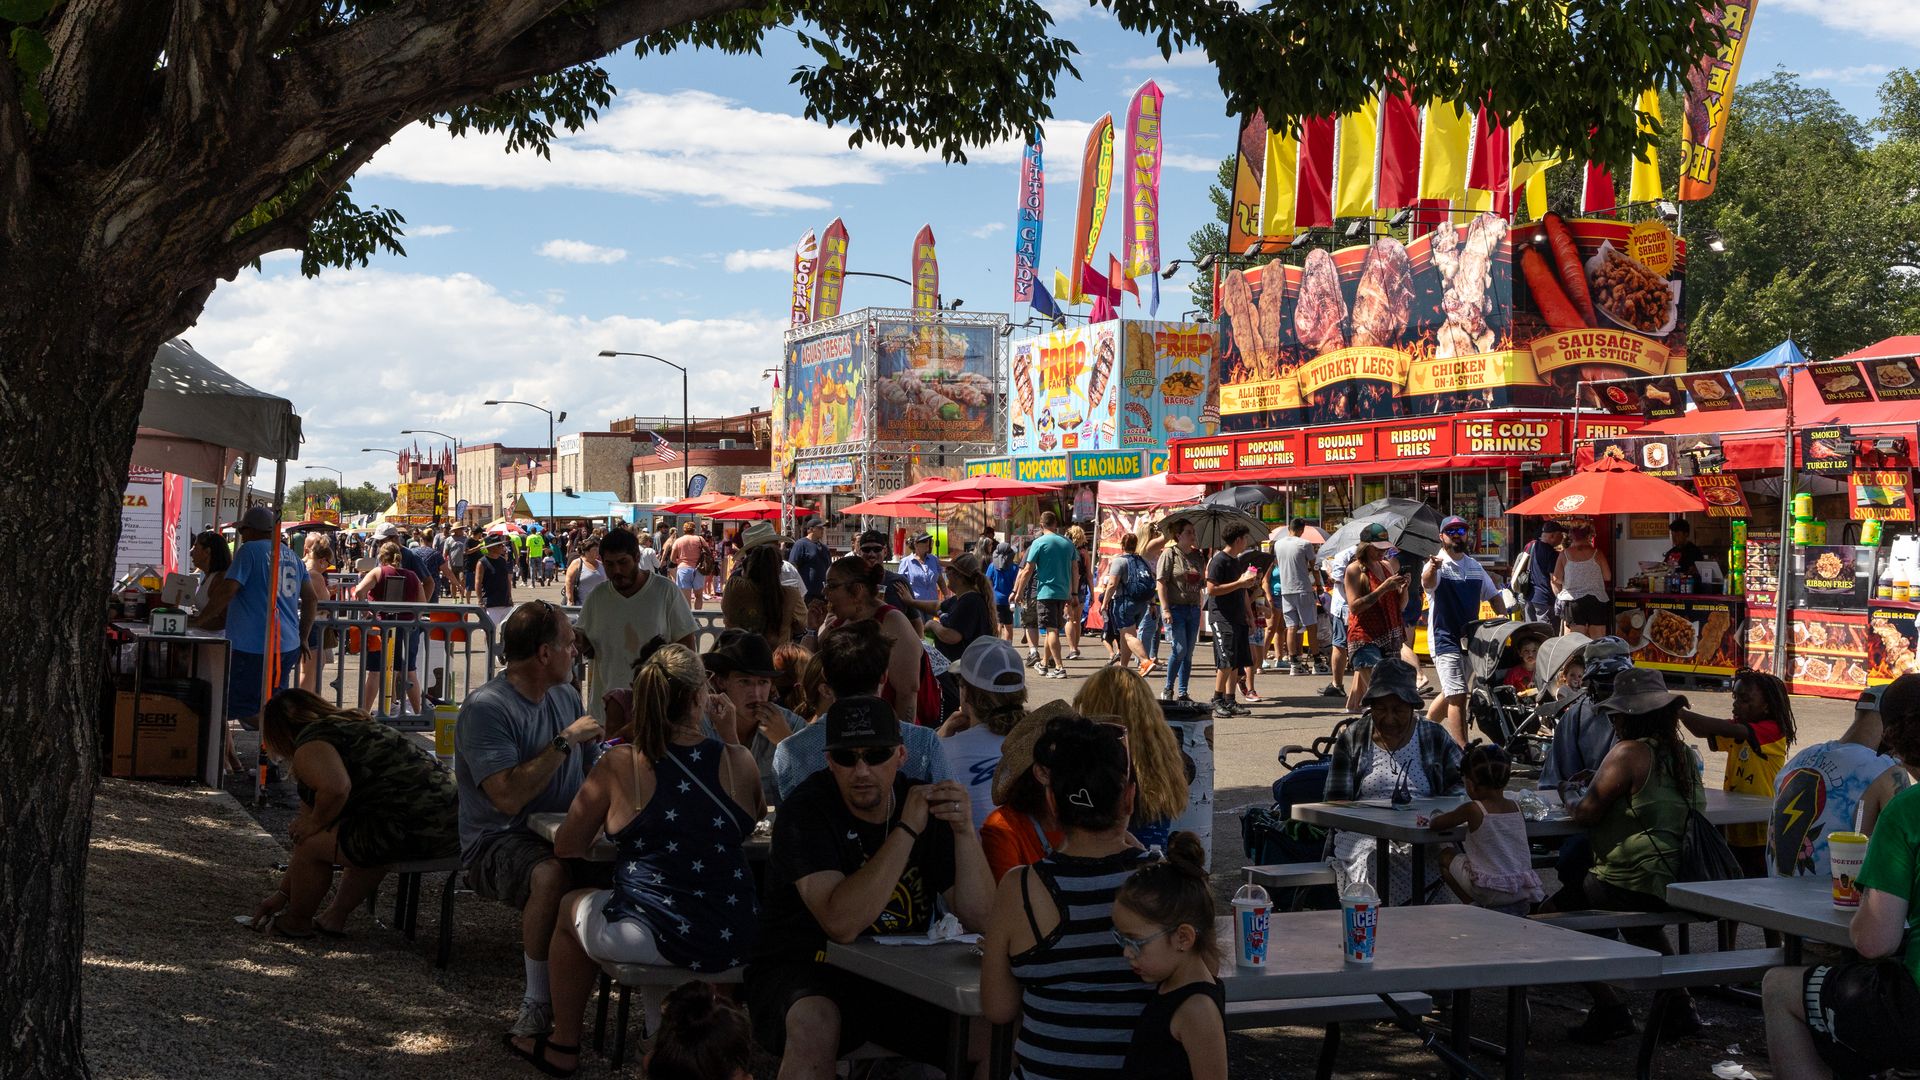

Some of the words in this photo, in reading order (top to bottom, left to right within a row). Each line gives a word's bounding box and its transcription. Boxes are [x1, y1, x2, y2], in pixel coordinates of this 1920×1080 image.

[1134, 95, 1159, 241] LEMONADE
[1634, 231, 1666, 246] POPCORN
[1638, 243, 1666, 256] SHRIMP
[1016, 227, 1036, 295] CANDY
[1646, 253, 1668, 266] FRIES
[820, 237, 848, 317] NACHO
[802, 341, 822, 366] AGUAS
[822, 334, 852, 360] FRESCAS
[1155, 331, 1213, 354] FRIED
[1557, 334, 1643, 353] SAUSAGE
[1040, 340, 1086, 381] FRIED
[1564, 348, 1638, 364] ON-A-STICK
[1311, 356, 1359, 386] TURKEY
[1362, 356, 1394, 377] LEGS
[1431, 358, 1487, 378] CHICKEN
[1815, 365, 1854, 374] ALLIGATOR
[1048, 375, 1077, 390] FANTASY
[1434, 373, 1485, 388] ON-A-STICK
[1238, 384, 1281, 399] ALLIGATOR
[1826, 391, 1867, 399] ON-A-STICK
[1899, 388, 1920, 396] PICKLE
[1163, 396, 1195, 406] NACHOS
[1240, 396, 1279, 409] ON-A-STICK
[1391, 427, 1437, 444] RIBBON
[1466, 424, 1493, 438] ICE
[1498, 423, 1549, 438] COLD
[1586, 424, 1629, 439] FRIED
[1811, 431, 1840, 440] SMOKED
[1123, 436, 1158, 445] BANANAS
[1248, 440, 1285, 454] POPCORN
[1317, 434, 1364, 449] BOUDAIN
[1471, 437, 1542, 452] DRINKS
[1184, 444, 1229, 459] BLOOMING
[1325, 447, 1357, 462] BALLS
[1397, 442, 1431, 457] FRIES
[1074, 455, 1140, 477] LEMONADE
[1193, 457, 1220, 470] ONION
[1239, 453, 1267, 467] SHRIMP
[1267, 454, 1273, 466] &
[1273, 451, 1295, 465] FRIES
[1806, 462, 1834, 470] TURKEY
[1018, 458, 1067, 480] POPCORN
[879, 478, 900, 490] DOG
[1698, 476, 1736, 487] ELOTES
[1852, 474, 1872, 486] ICE
[1875, 474, 1908, 486] COLD
[1854, 507, 1911, 520] SNOWCONE
[1806, 580, 1832, 588] RIBBON
[1833, 580, 1853, 589] FRIES
[162, 618, 177, 632] 13
[1818, 755, 1844, 788] WILD
[1352, 911, 1377, 928] ICEE
